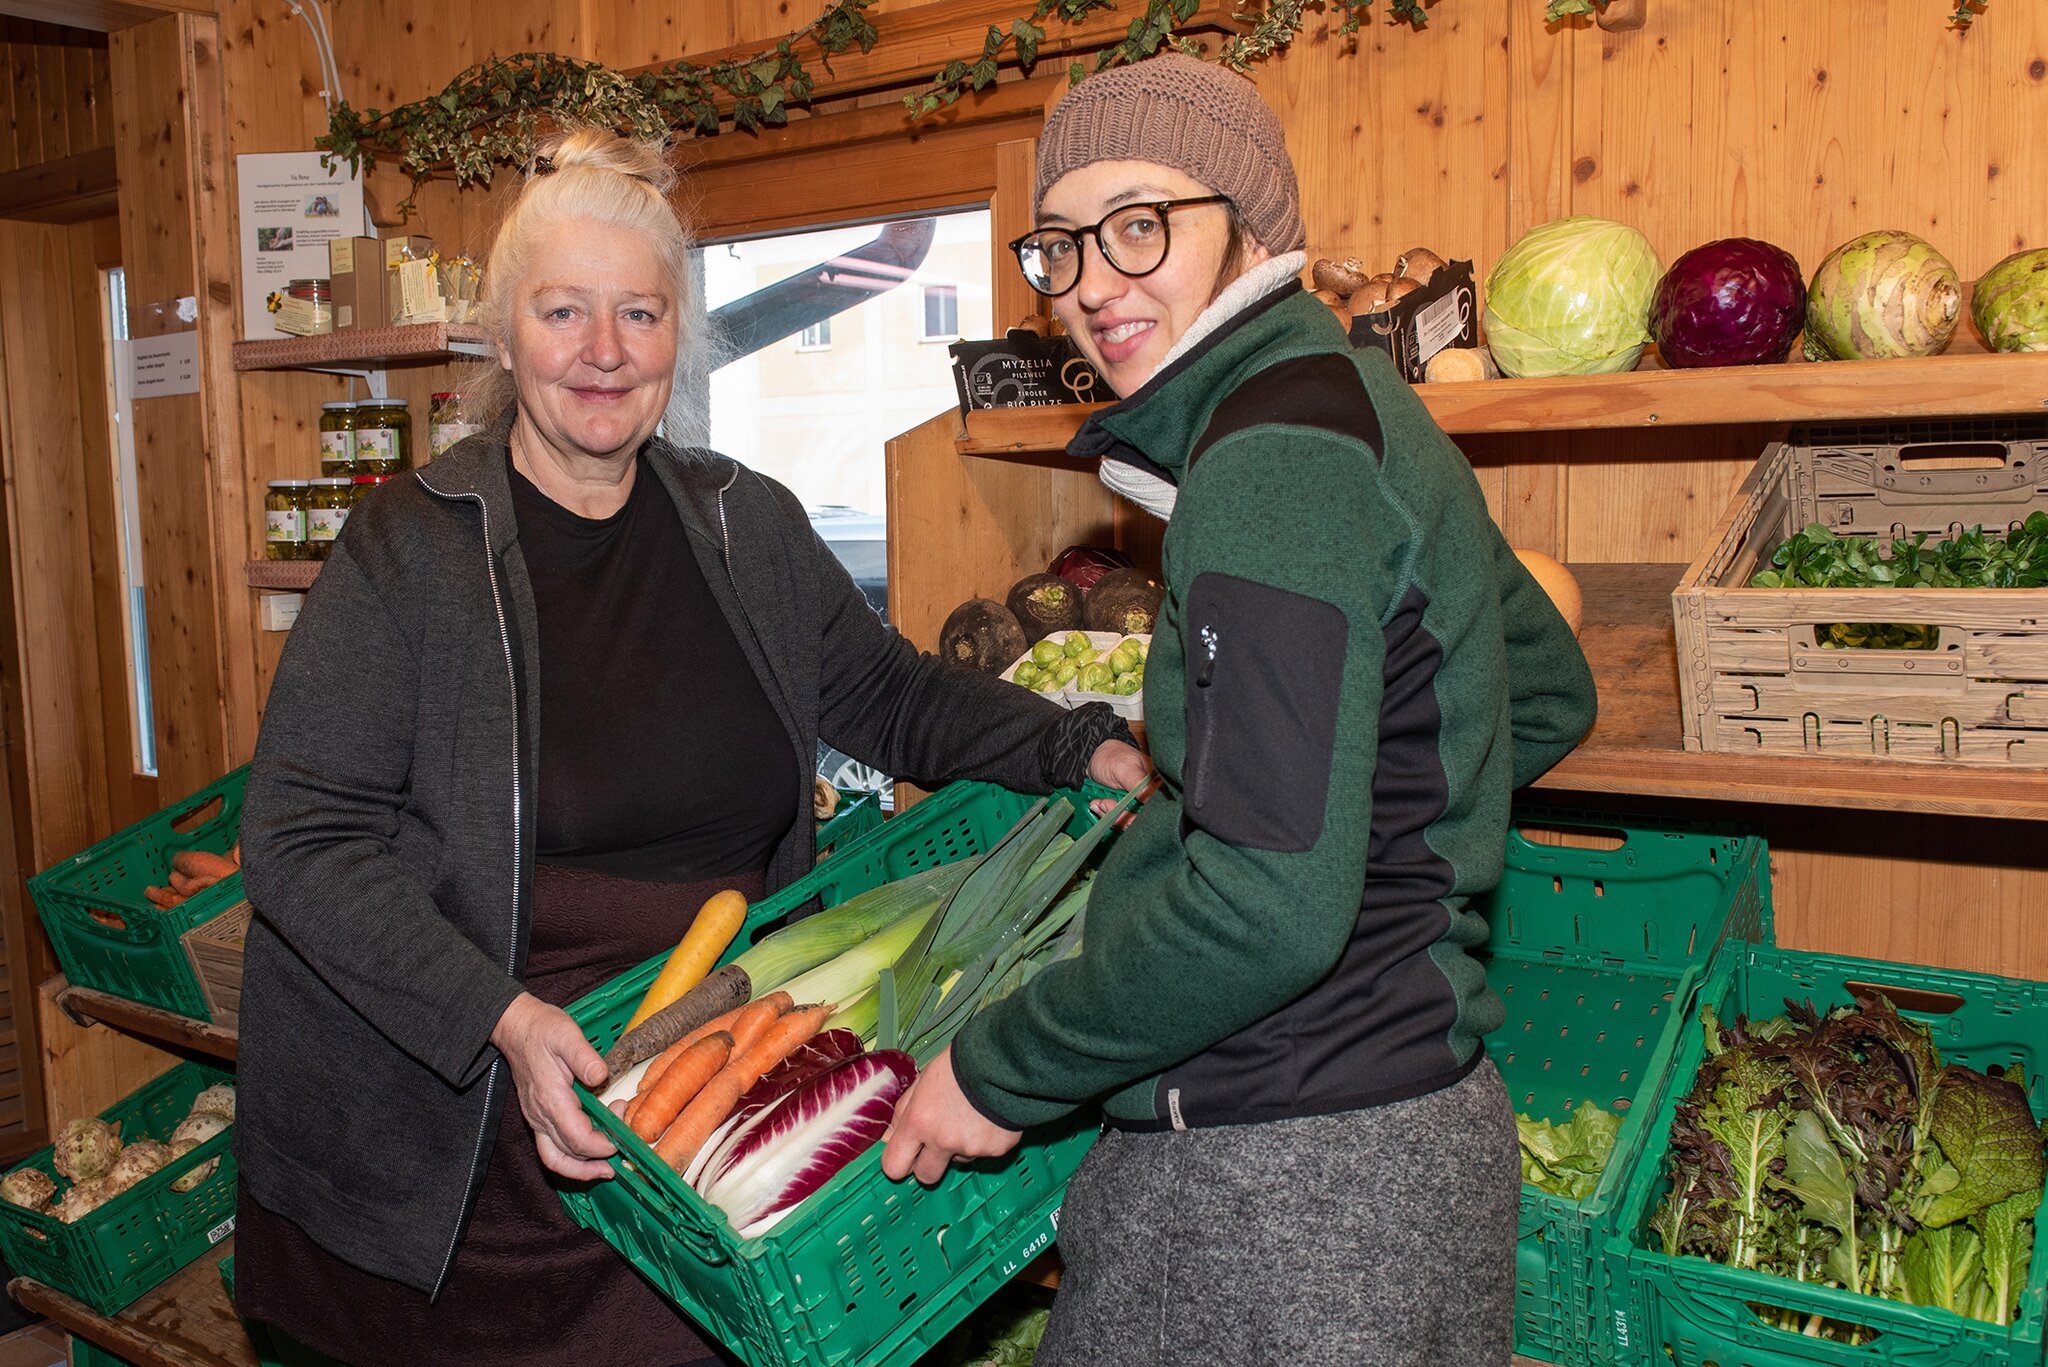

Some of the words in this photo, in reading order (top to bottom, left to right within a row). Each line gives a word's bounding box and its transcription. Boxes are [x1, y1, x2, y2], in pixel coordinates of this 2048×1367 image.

[1002, 359, 1053, 370] MYZELIA
[1012, 371, 1046, 379] PILZWELT
[1007, 400, 1026, 408] BIO
[1003, 1260, 1017, 1276] LL
[1022, 1232, 1048, 1258] 6418
[1614, 1309, 1629, 1347] LL4314
